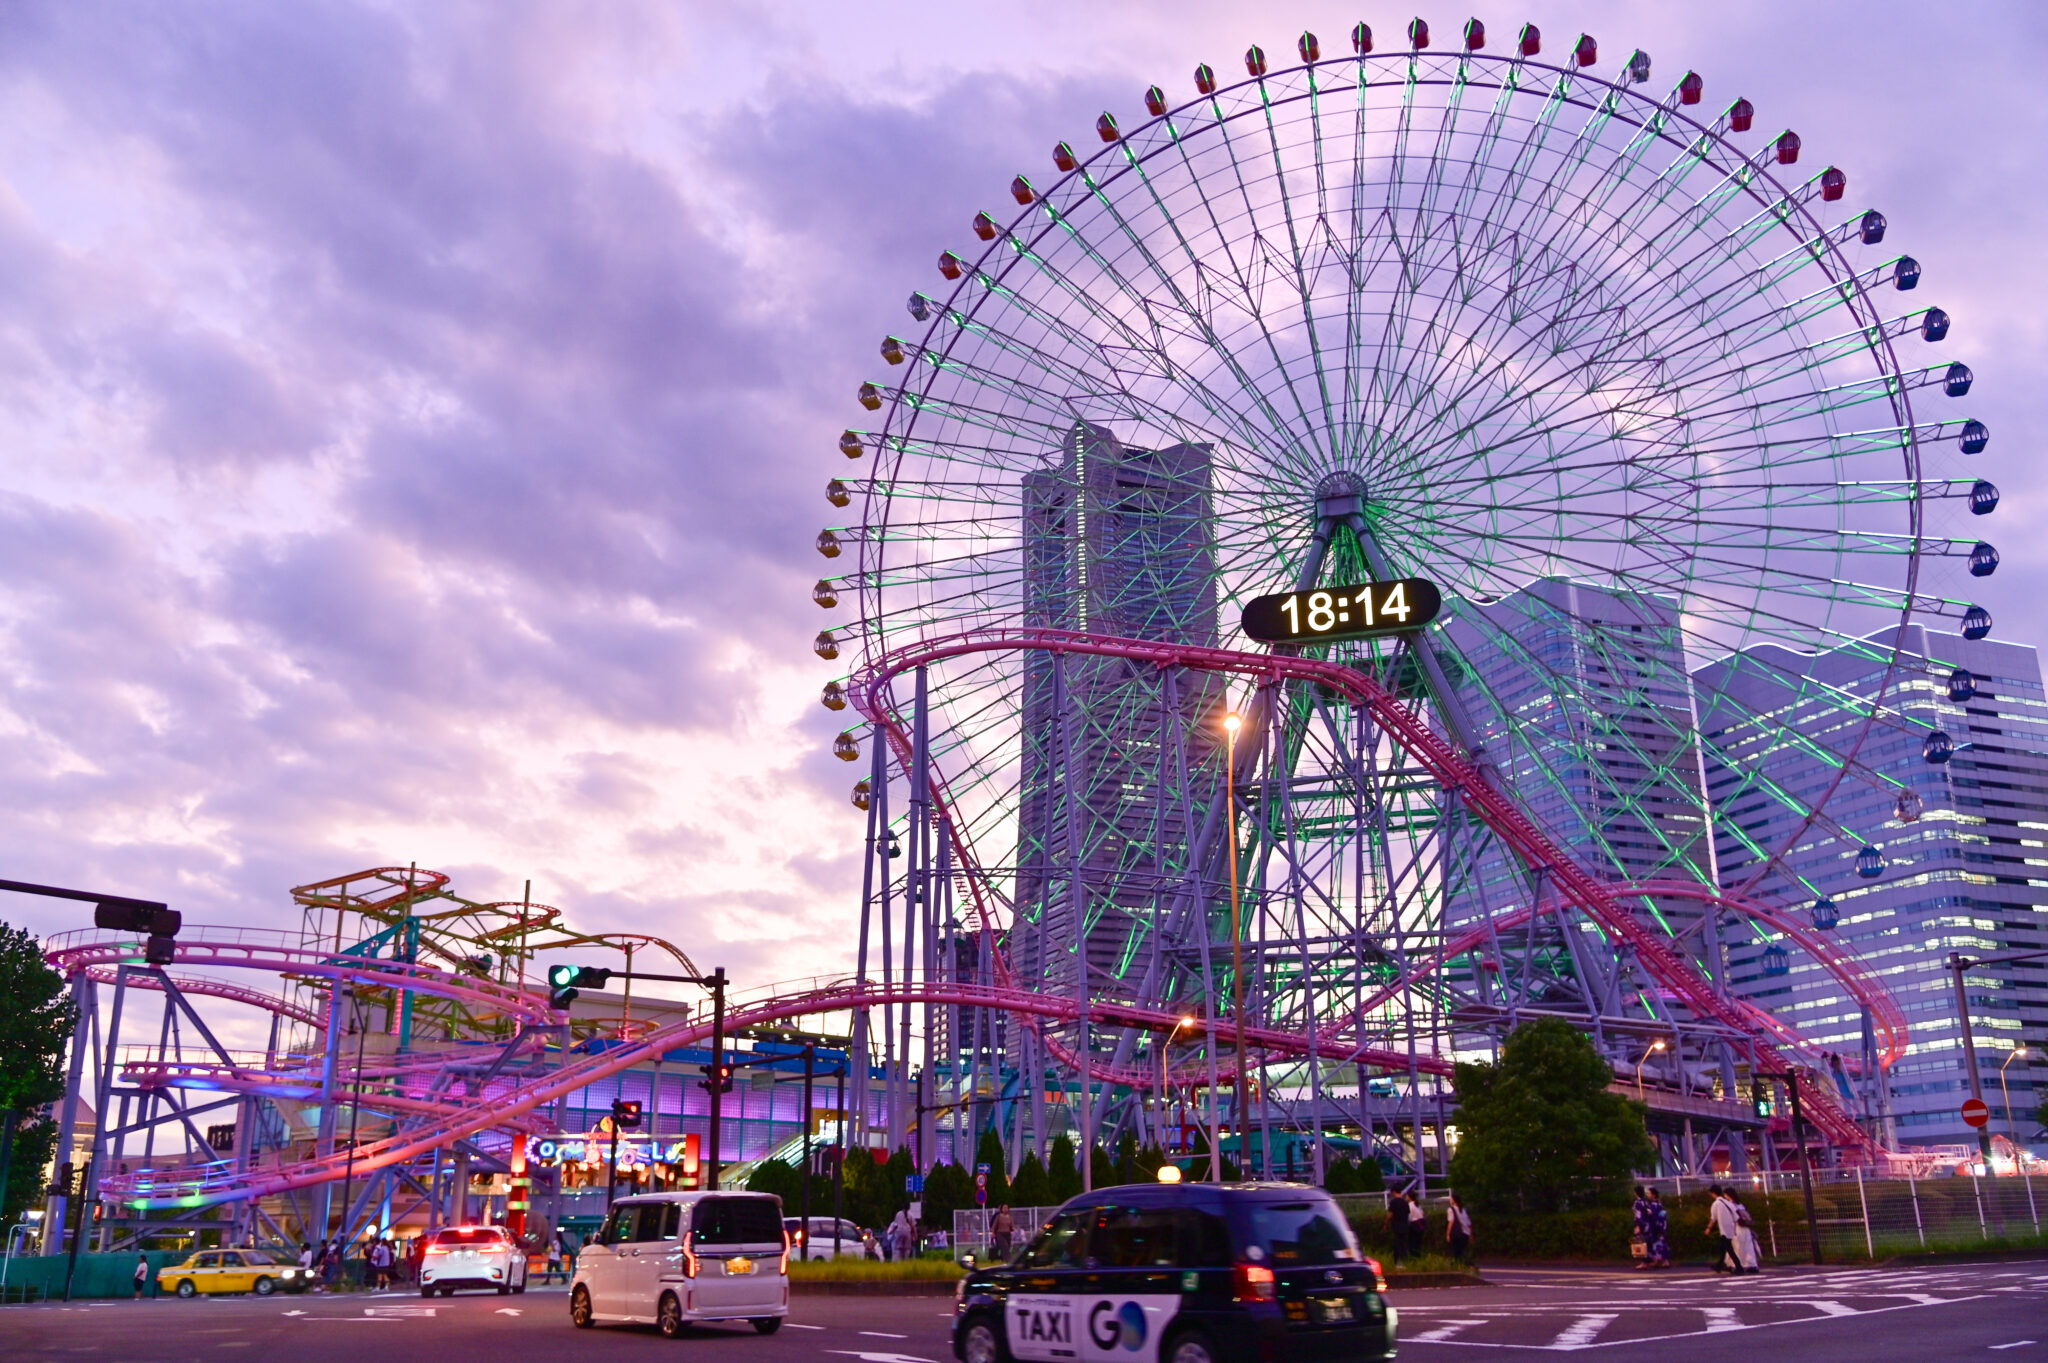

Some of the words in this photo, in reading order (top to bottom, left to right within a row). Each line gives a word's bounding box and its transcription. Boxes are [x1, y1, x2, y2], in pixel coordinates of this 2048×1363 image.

[1281, 582, 1411, 634] 18:14
[1016, 1309, 1072, 1344] TAXI
[1089, 1300, 1148, 1352] GO
